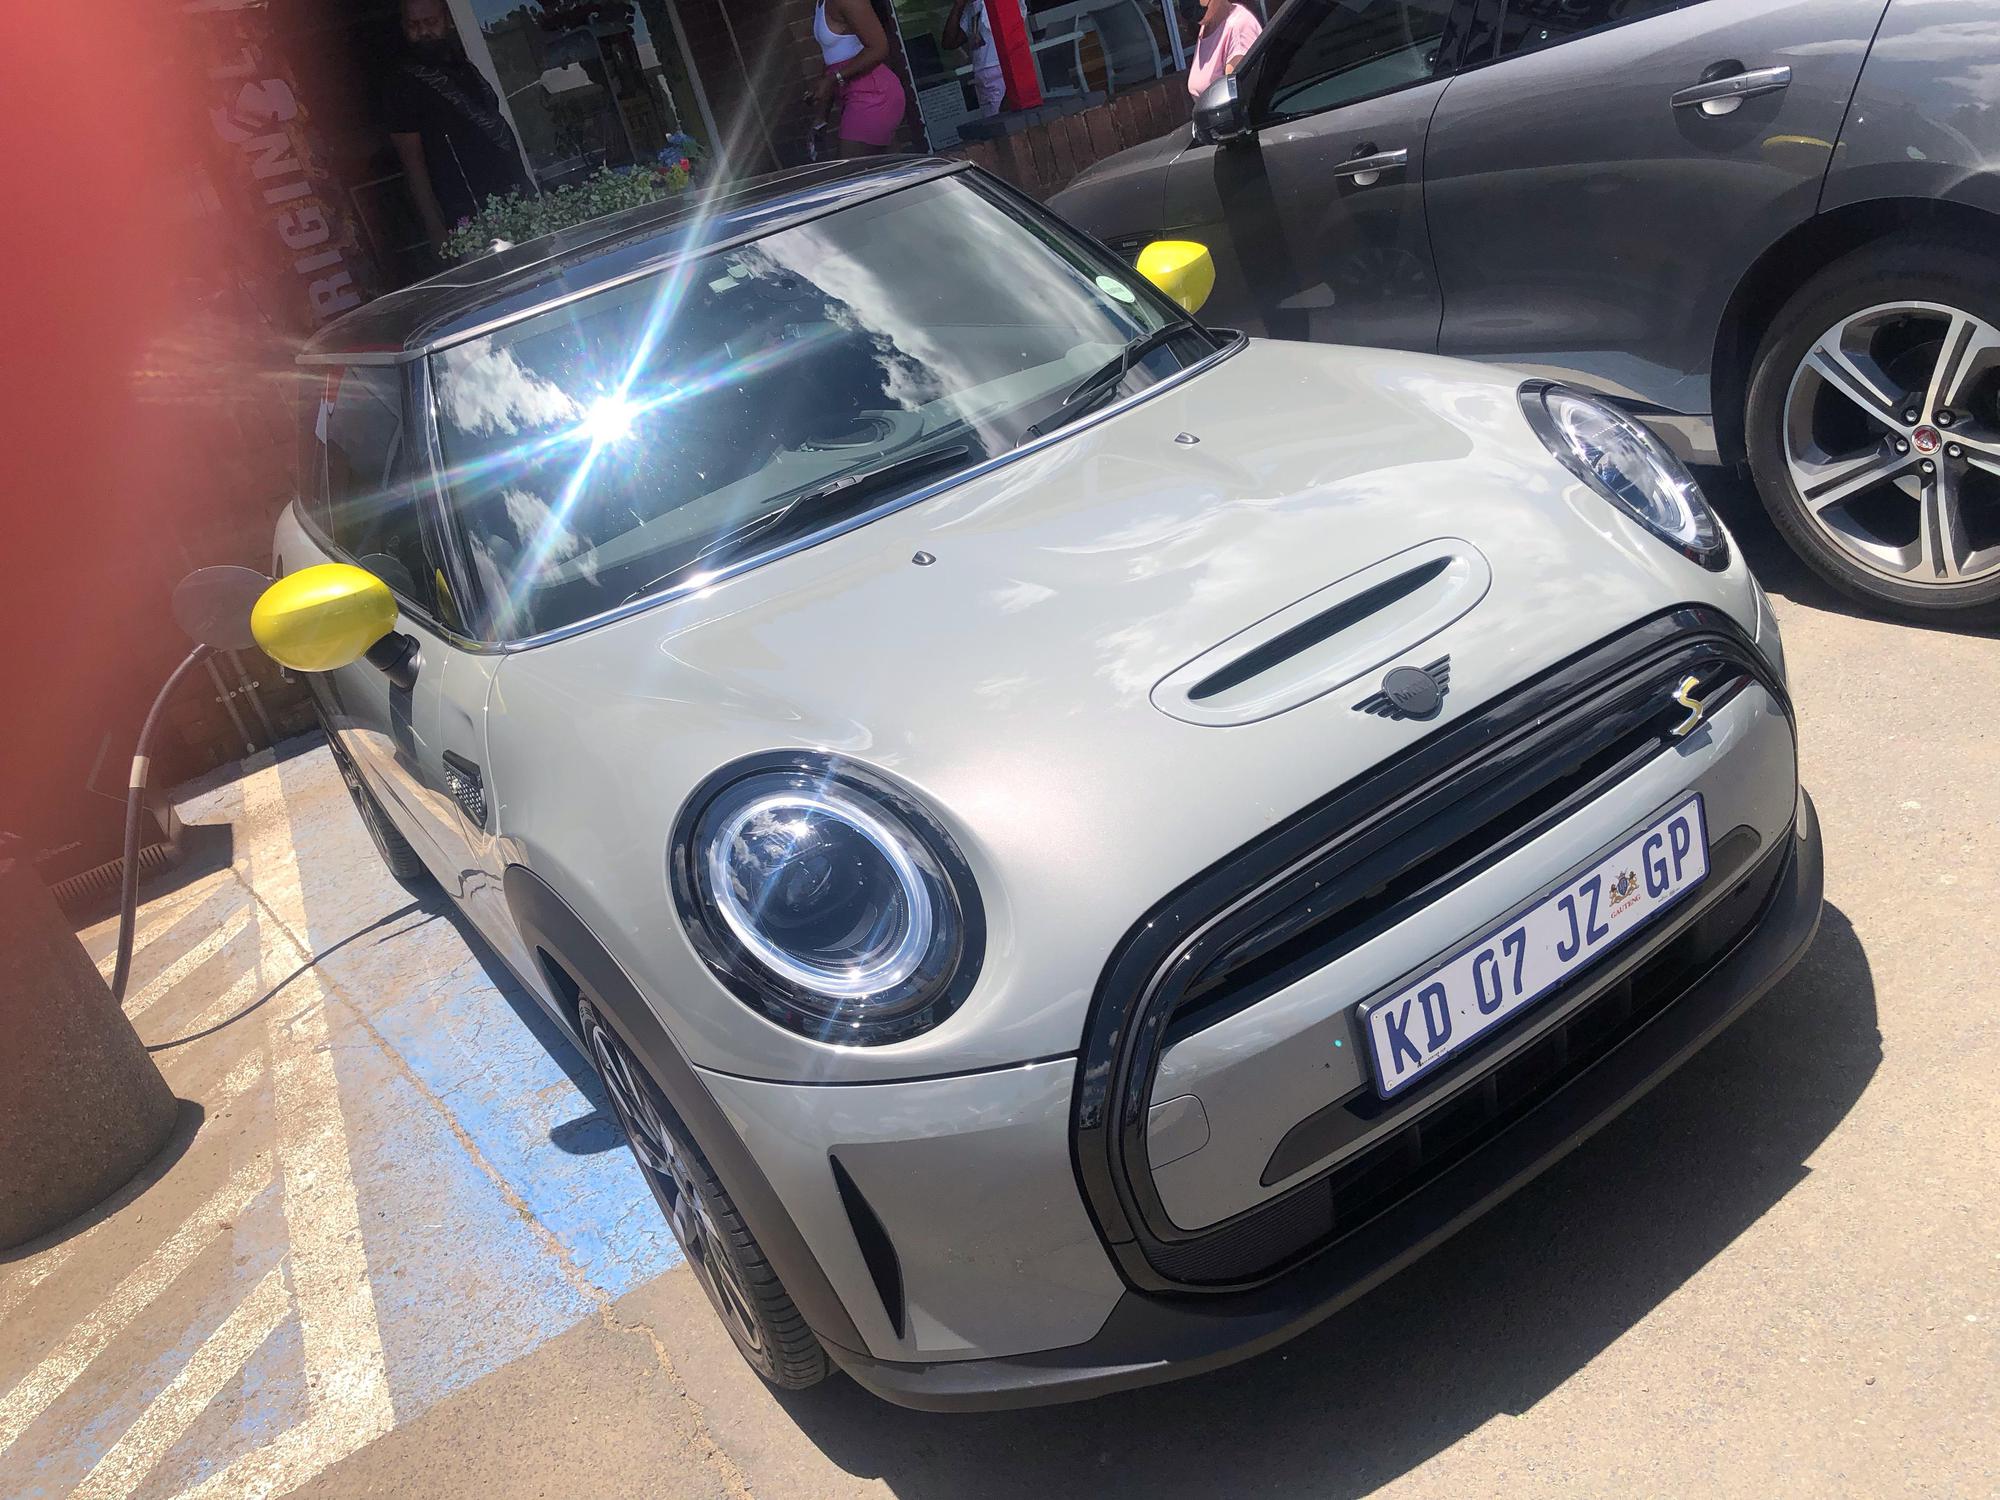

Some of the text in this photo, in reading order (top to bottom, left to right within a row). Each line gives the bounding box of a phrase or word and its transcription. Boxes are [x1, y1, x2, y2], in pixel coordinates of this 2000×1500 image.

[1670, 676, 1704, 736] S
[1610, 894, 1641, 919] GAUTENG
[1385, 816, 1691, 1075] KD 07 JZ GP
